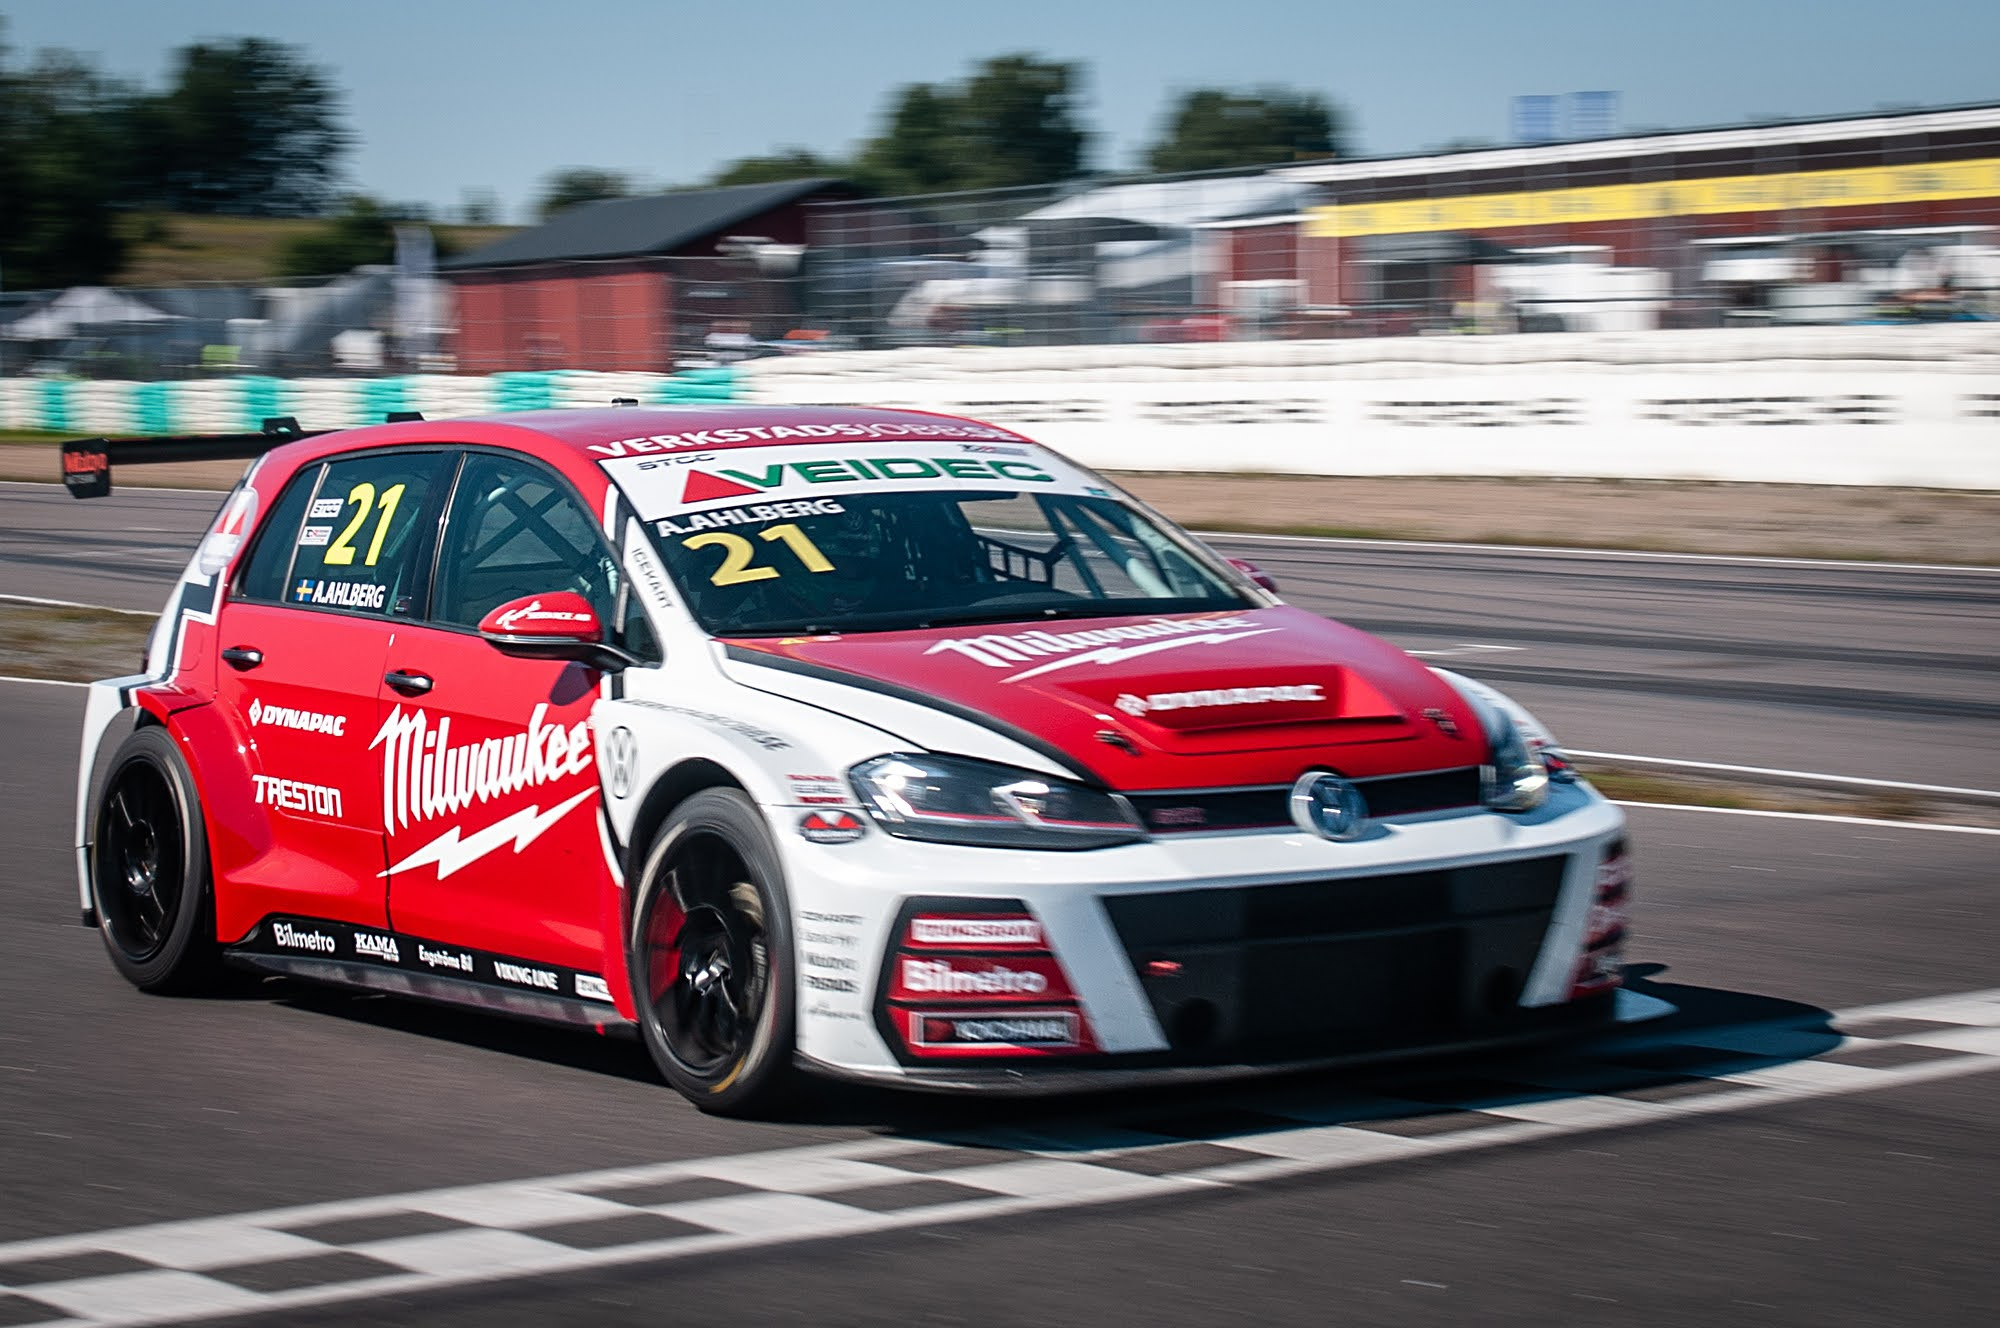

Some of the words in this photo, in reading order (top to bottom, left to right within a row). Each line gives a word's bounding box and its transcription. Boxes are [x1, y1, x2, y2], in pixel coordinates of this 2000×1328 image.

[637, 453, 716, 471] STCC
[716, 457, 1056, 488] VEIDEC
[323, 482, 405, 566] 21
[656, 499, 846, 537] A.AHLBERG
[682, 524, 837, 587] 21
[312, 580, 387, 609] A.AHLBERG
[923, 617, 1264, 668] Milwaukee
[261, 705, 347, 737] DYNAPAC
[367, 702, 594, 837] Milwaukee
[252, 774, 343, 819] TRESTON
[273, 923, 336, 953] Bilmetro
[354, 932, 399, 954] KAMA
[902, 958, 1048, 993] Bilmetro
